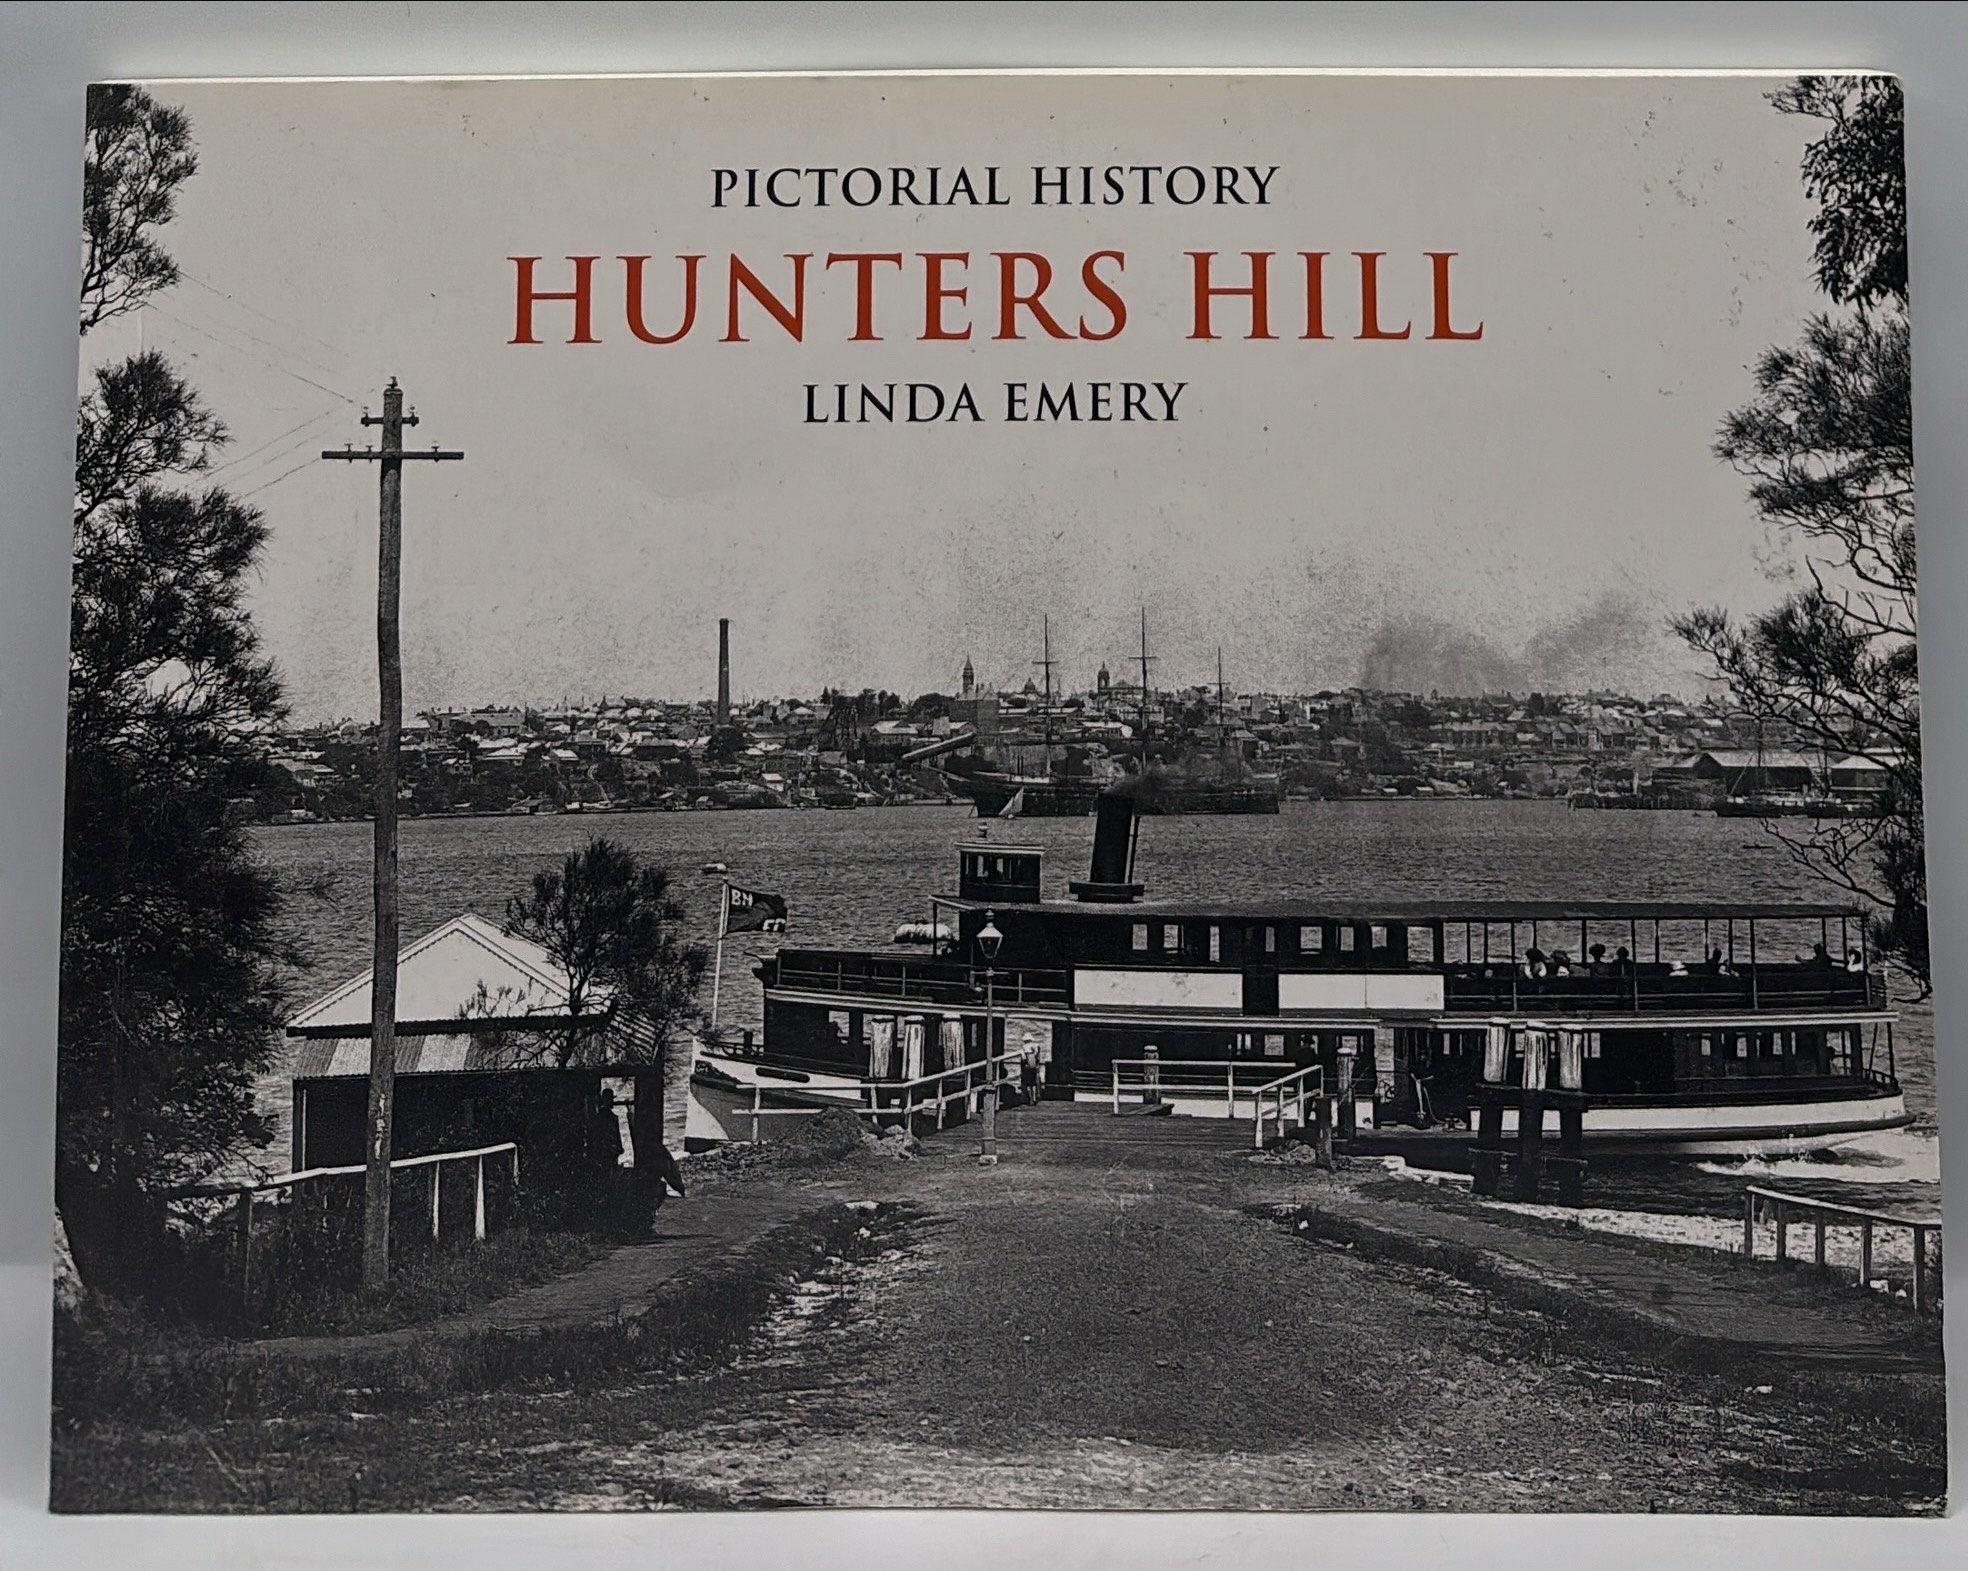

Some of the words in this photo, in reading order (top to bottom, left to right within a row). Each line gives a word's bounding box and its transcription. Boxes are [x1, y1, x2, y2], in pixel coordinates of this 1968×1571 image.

[710, 166, 1011, 208] PICTORIAL
[1031, 165, 1281, 206] HISTORY
[505, 250, 1128, 345] HUNTERS
[1183, 251, 1484, 343] HILL
[802, 382, 986, 424] LINDA
[1003, 381, 1189, 422] EMERY
